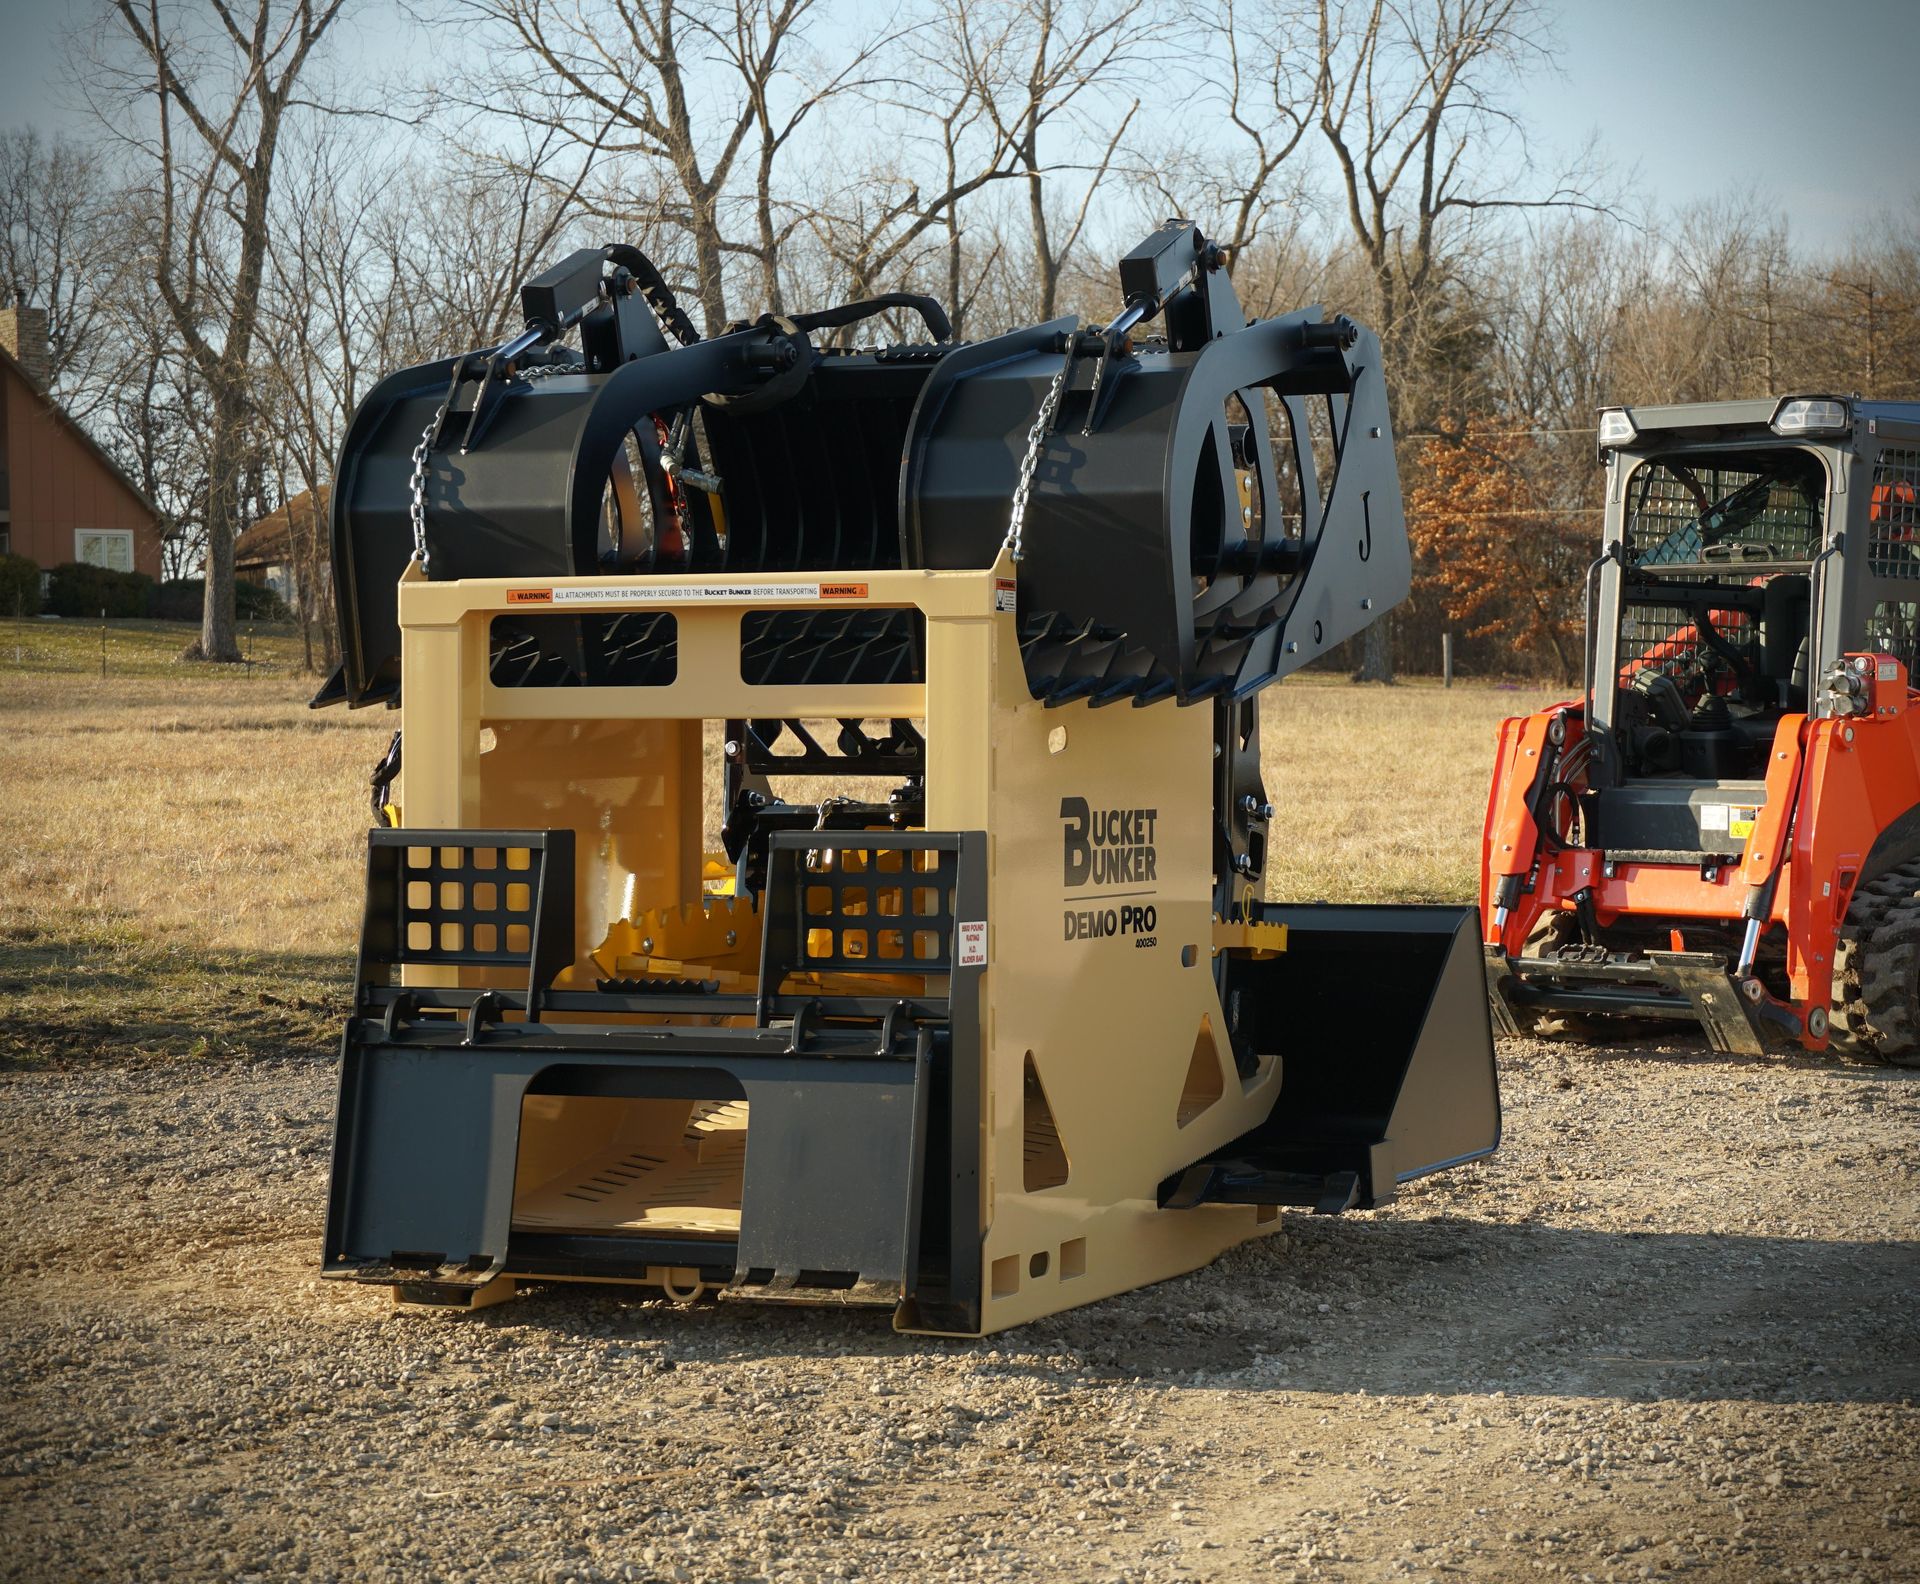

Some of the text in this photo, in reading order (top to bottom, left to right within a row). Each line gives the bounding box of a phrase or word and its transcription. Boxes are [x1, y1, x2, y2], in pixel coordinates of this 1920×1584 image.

[517, 586, 857, 600] WARNING ALL ATTACHMENTS MUST BE PROPERLY SECURED TO THE BUCKET BUNKER BEFORE TRANSPORTING WARNING
[1060, 796, 1157, 848] BUCKET
[1064, 840, 1157, 887] BUNKER
[1064, 905, 1157, 941] DEMO PRO
[1135, 937, 1157, 948] 400250
